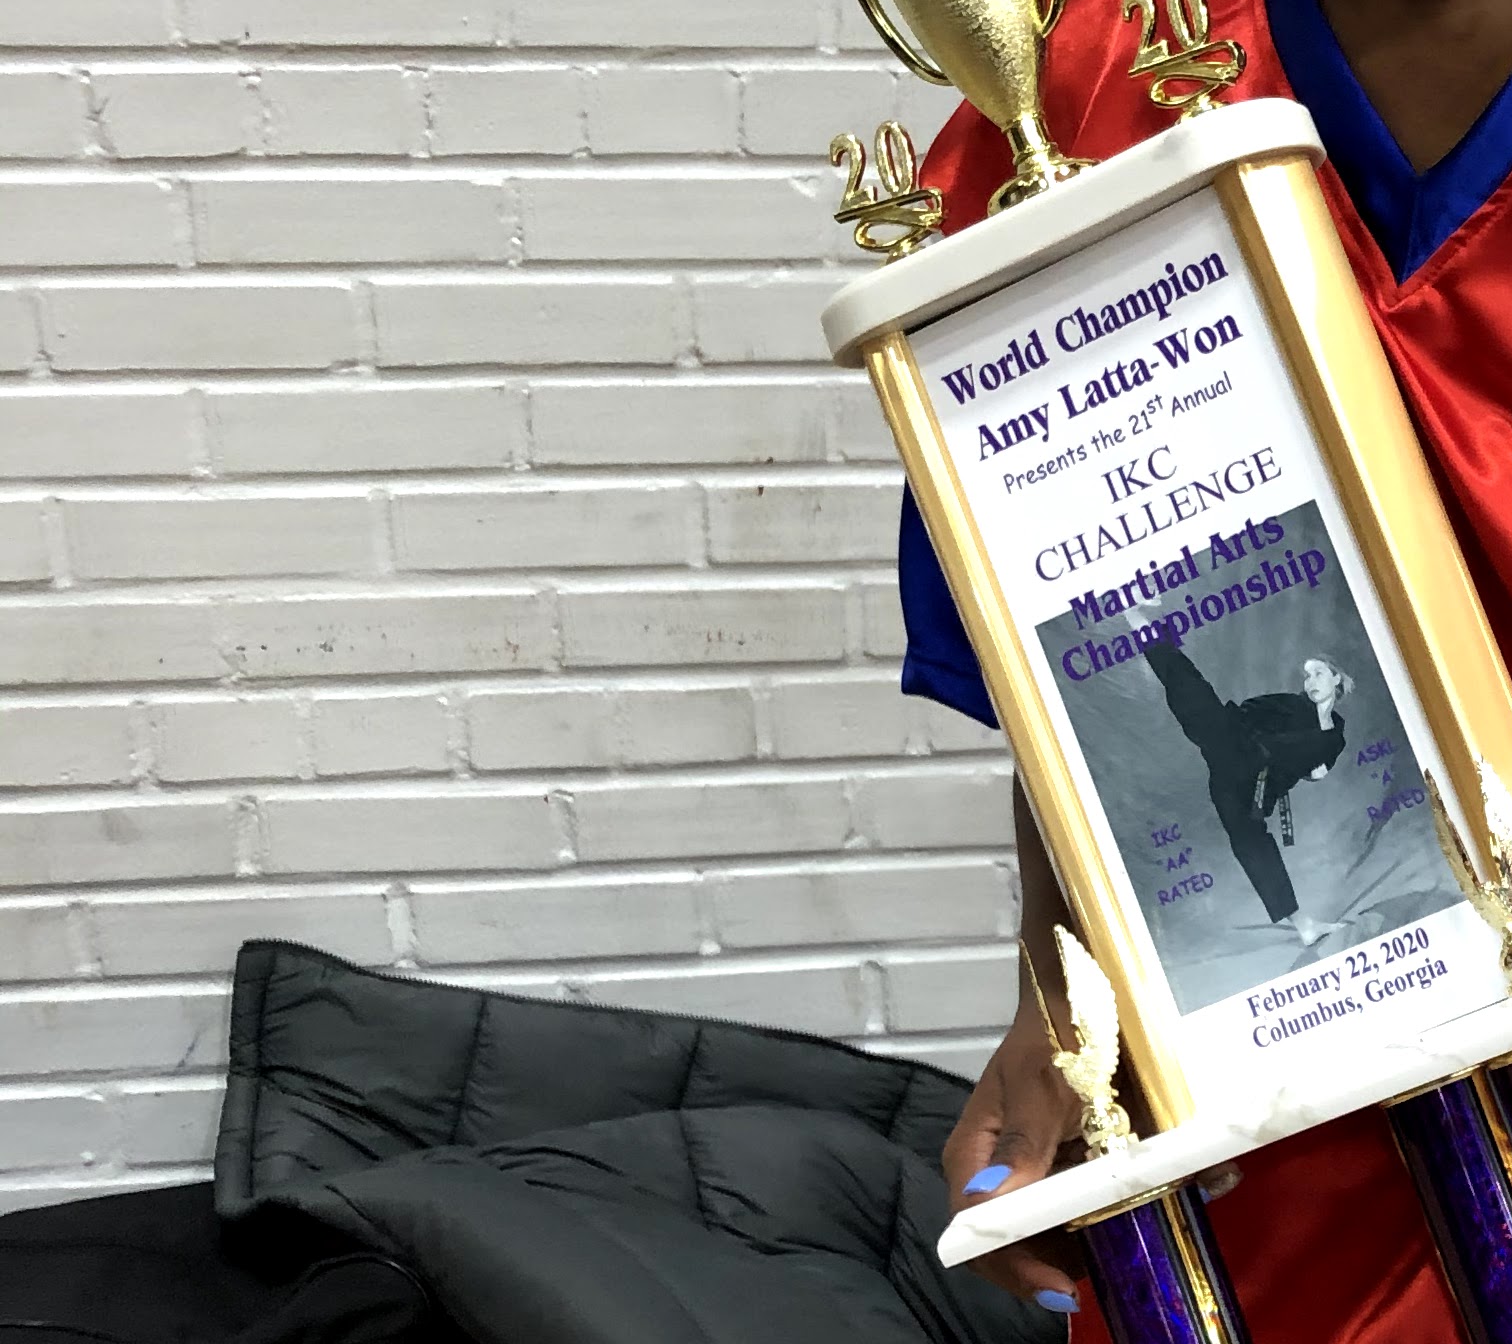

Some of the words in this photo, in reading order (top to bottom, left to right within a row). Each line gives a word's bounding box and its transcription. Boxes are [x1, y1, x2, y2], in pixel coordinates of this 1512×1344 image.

[829, 120, 917, 218] 20
[941, 329, 1050, 405] World
[1055, 252, 1229, 353] Champion
[977, 403, 1049, 461] Amy
[1057, 314, 1243, 419] Latta-Won
[1003, 444, 1088, 494] Presents
[1091, 426, 1126, 453] the
[1128, 394, 1164, 436] 21st
[1171, 370, 1233, 417] Annual
[1035, 446, 1283, 581] CHALLENGE
[1101, 445, 1178, 504] IKC
[1061, 548, 1326, 682] Championship
[1068, 545, 1200, 631] Martial
[1208, 515, 1284, 570] Arts
[1151, 823, 1182, 849] IKC
[1366, 787, 1425, 823] RATED
[1157, 872, 1214, 906] RATED
[1246, 967, 1341, 1018] February
[1345, 951, 1379, 979] 22,
[1380, 927, 1430, 965] 2020
[1252, 996, 1364, 1048] Columbus,
[1364, 957, 1448, 1003] Georgia
